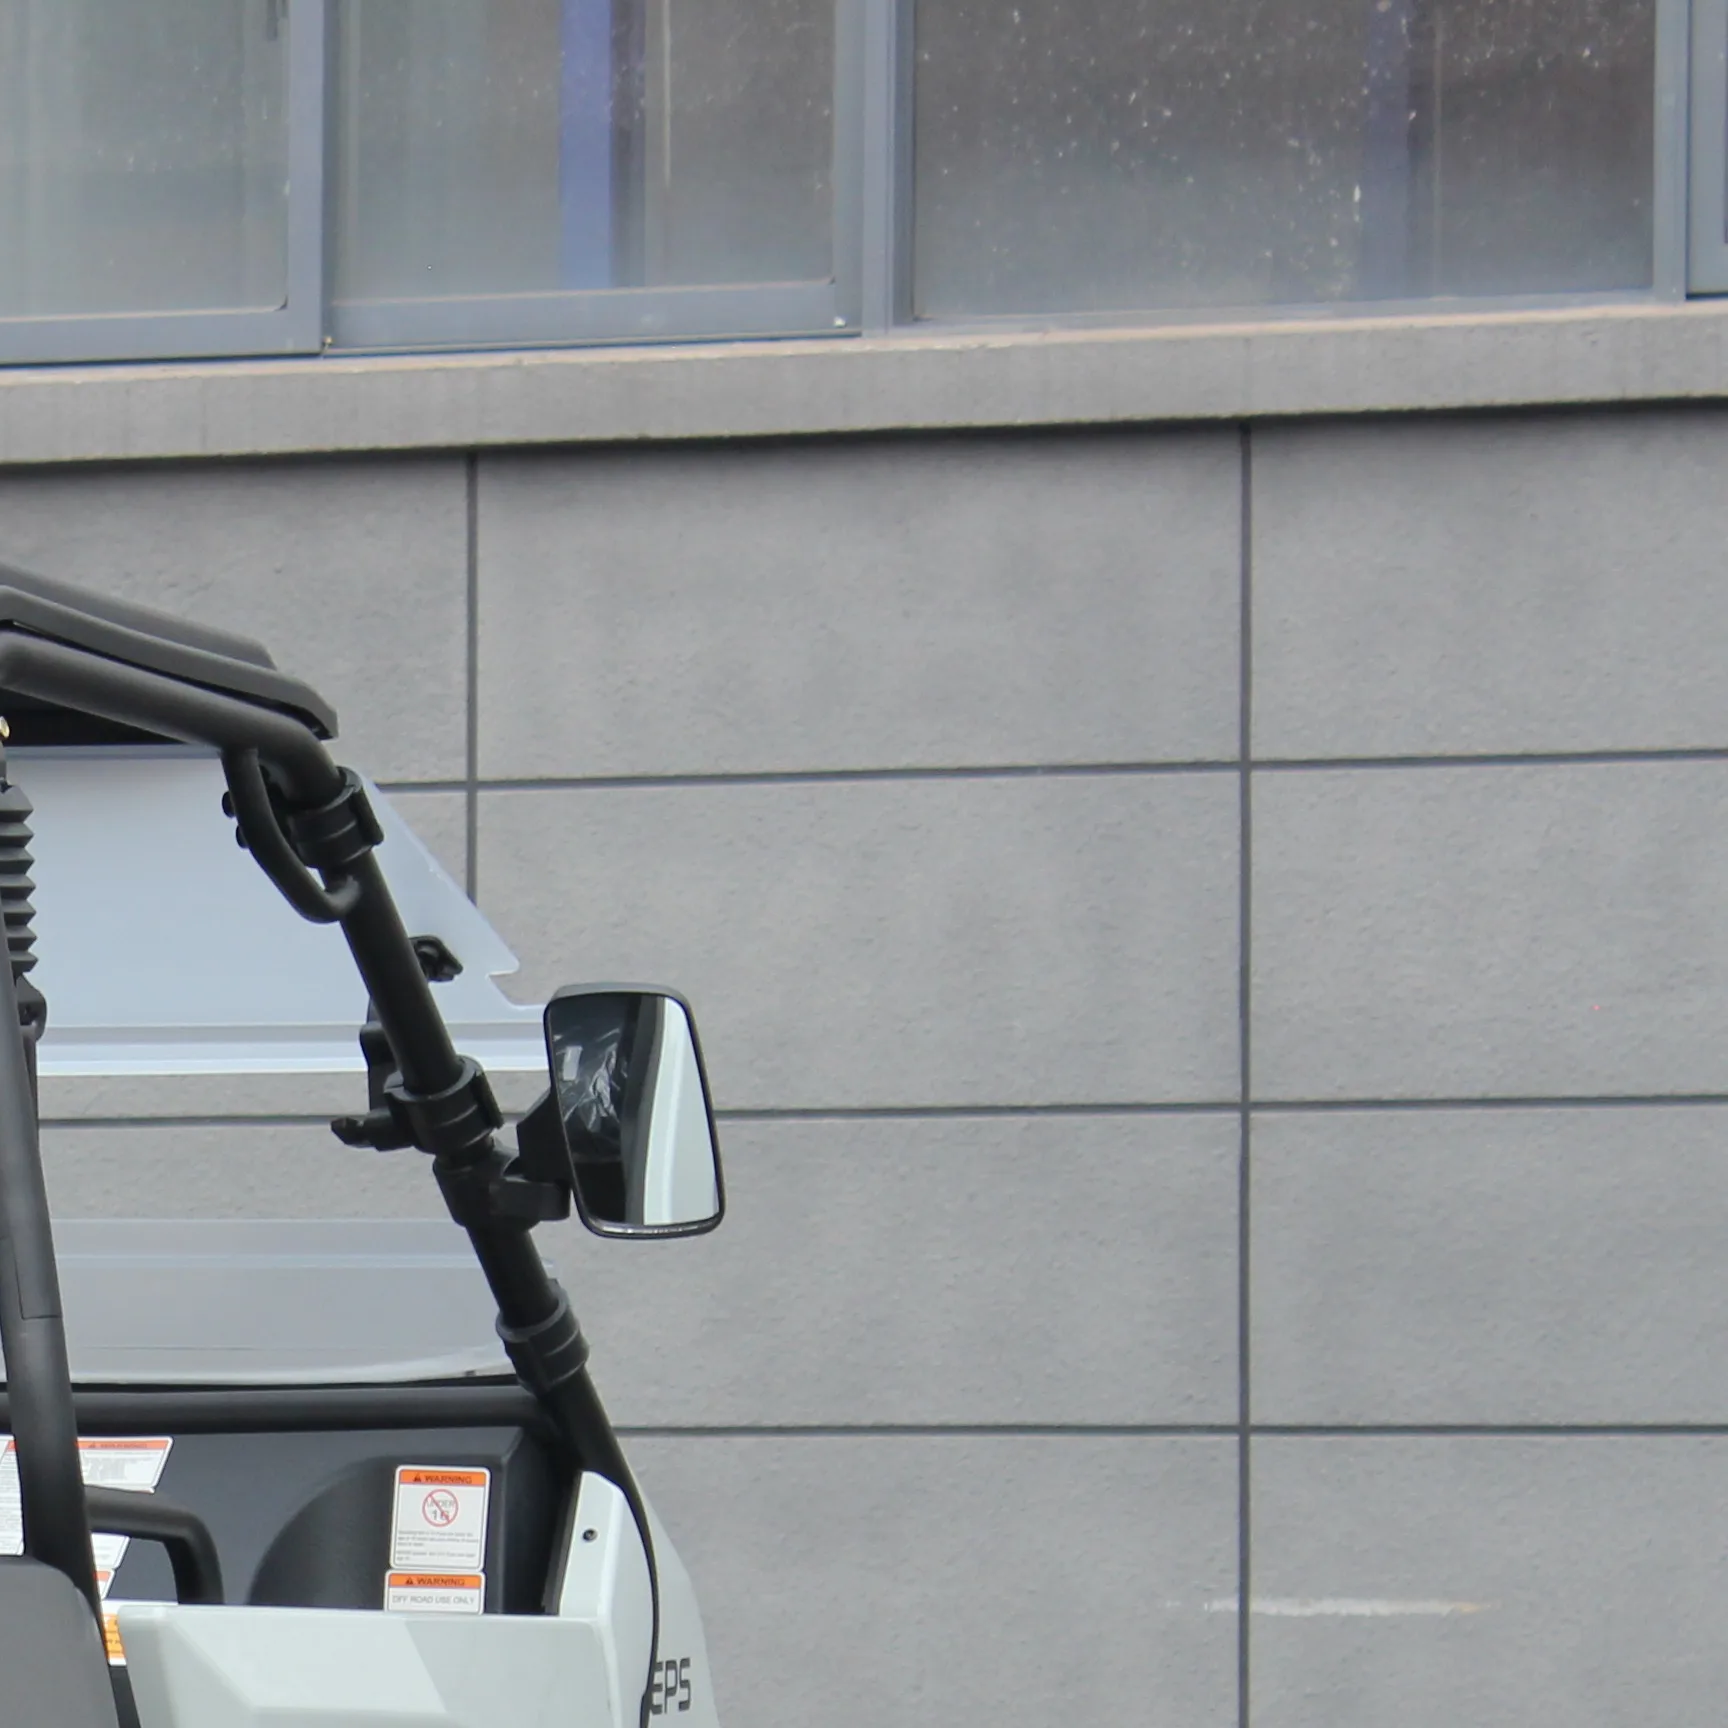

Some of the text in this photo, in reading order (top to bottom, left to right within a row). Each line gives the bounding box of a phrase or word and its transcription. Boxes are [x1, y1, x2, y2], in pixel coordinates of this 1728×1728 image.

[424, 1475, 472, 1484] WARNING
[417, 1577, 465, 1586] WARNING
[410, 1595, 433, 1604] ROAD
[435, 1596, 451, 1604] USE
[453, 1596, 475, 1605] ONLY
[650, 1657, 691, 1715] EPS
